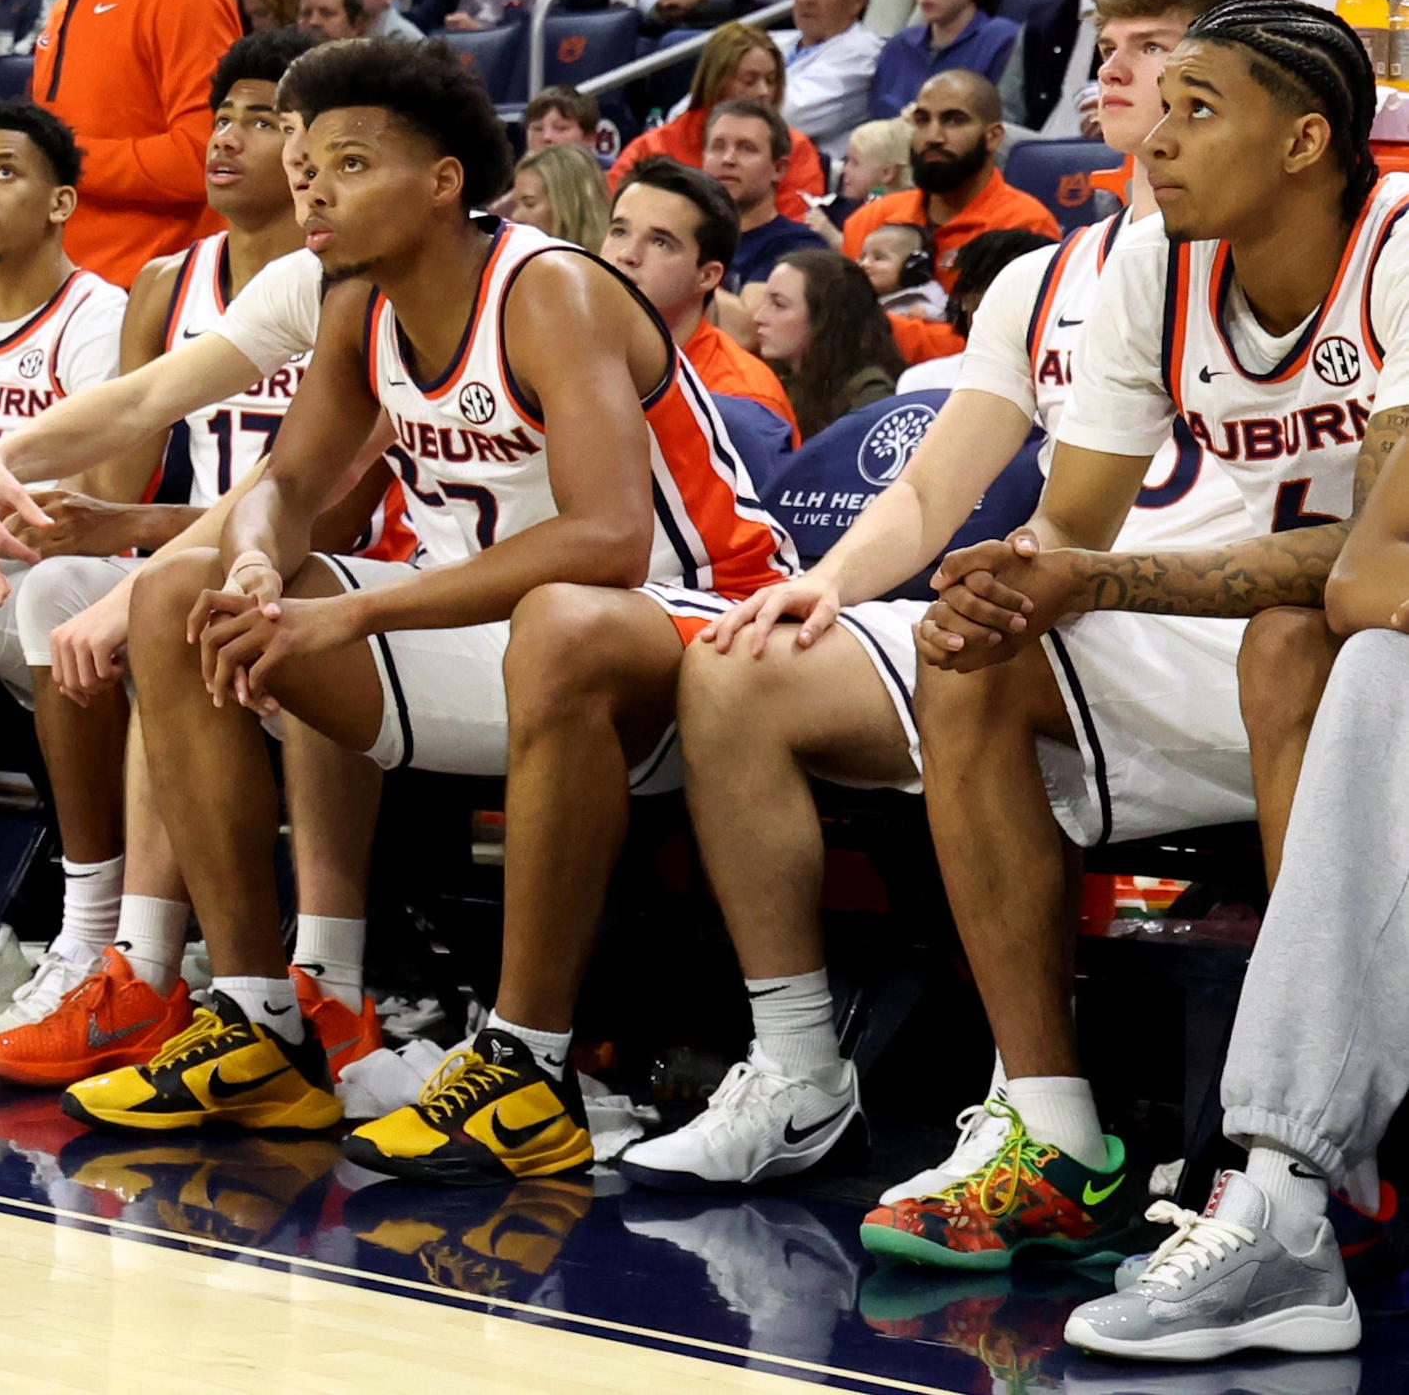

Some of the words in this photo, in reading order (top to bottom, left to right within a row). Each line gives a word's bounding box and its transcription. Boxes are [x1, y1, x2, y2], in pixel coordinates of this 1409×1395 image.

[1314, 338, 1360, 385] SEC
[461, 384, 494, 422] SEC
[207, 409, 284, 496] 17
[779, 489, 826, 509] LLH
[793, 512, 832, 526] LIVE
